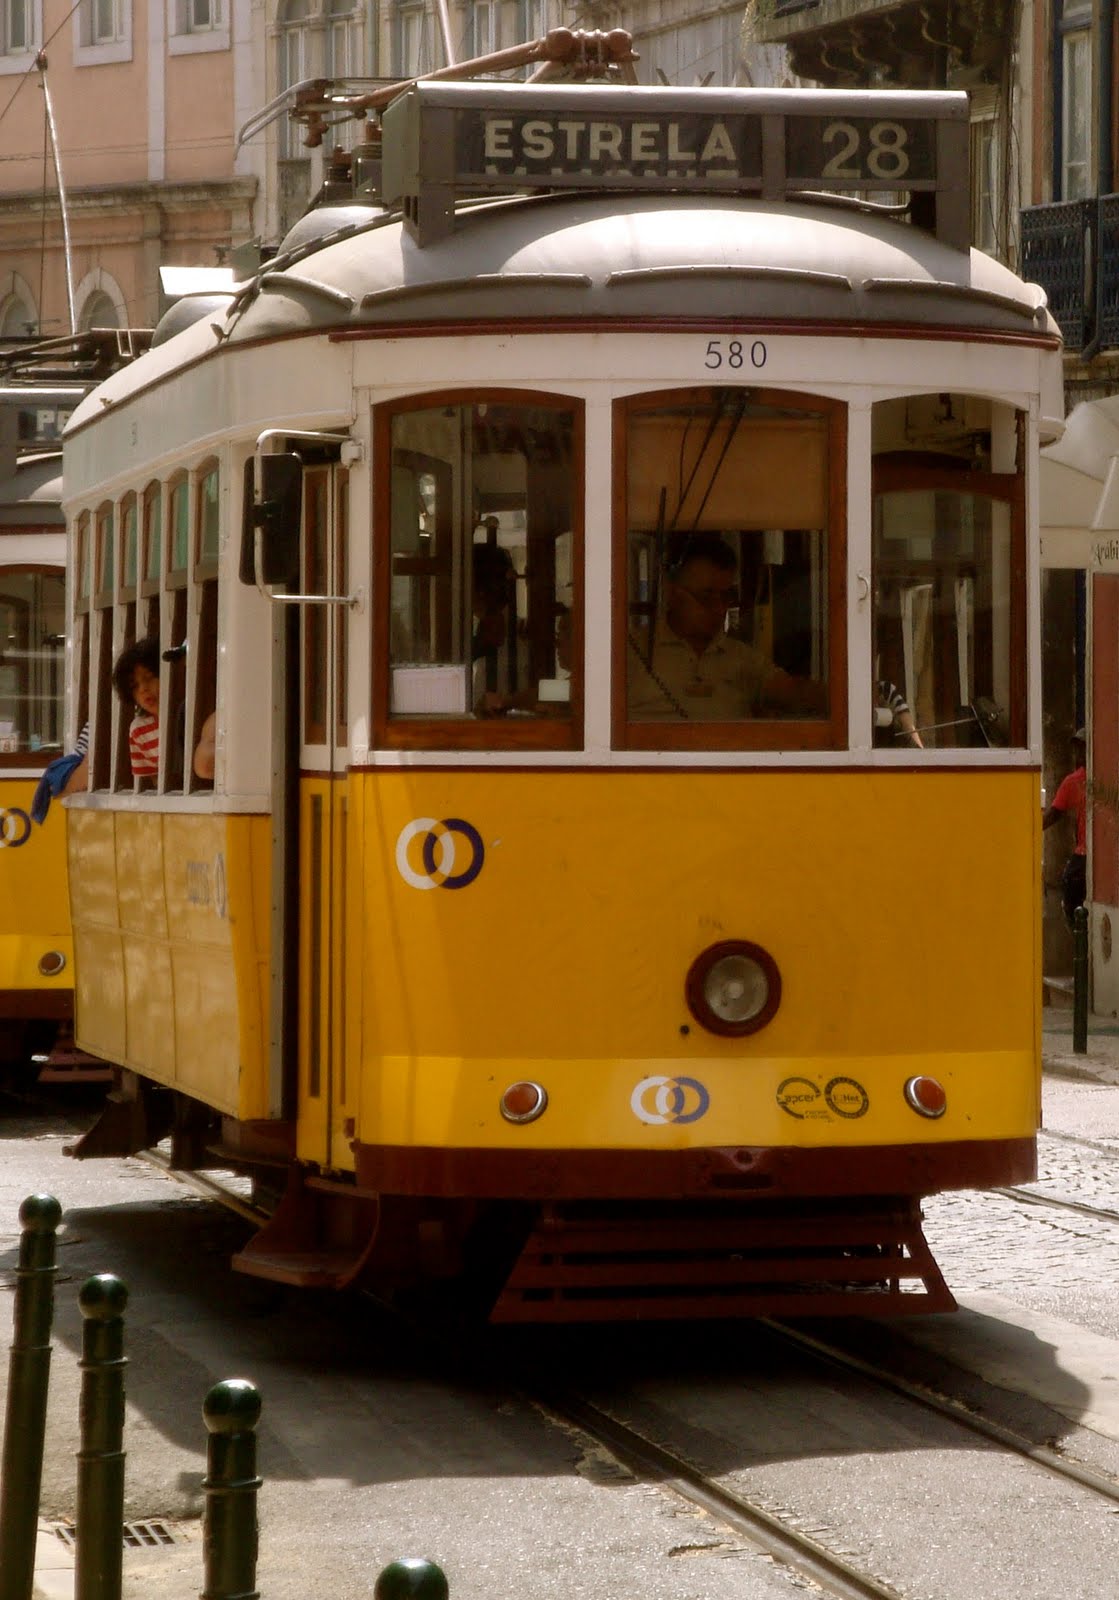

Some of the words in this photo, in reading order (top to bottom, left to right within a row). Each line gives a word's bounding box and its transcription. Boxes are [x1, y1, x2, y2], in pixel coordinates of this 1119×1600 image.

[484, 119, 738, 161] ESTRELA
[821, 121, 910, 179] 28
[704, 340, 767, 369] 580
